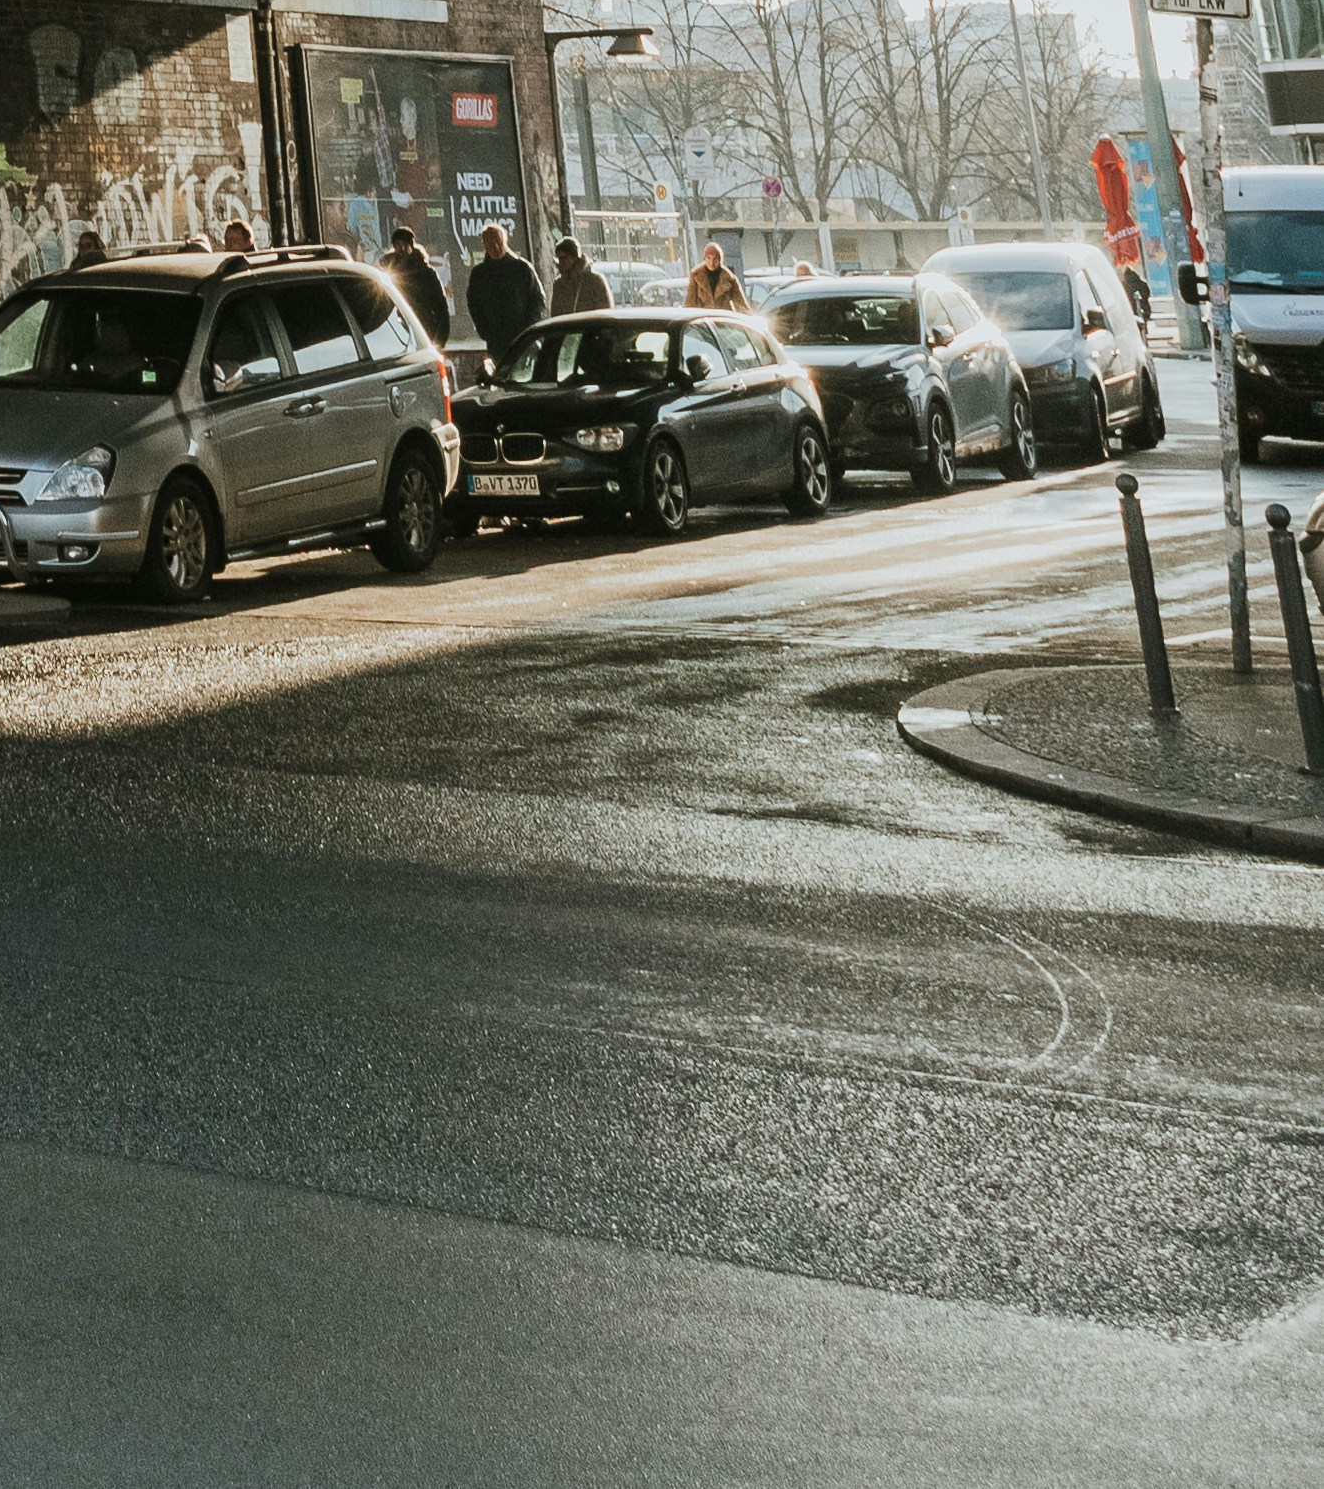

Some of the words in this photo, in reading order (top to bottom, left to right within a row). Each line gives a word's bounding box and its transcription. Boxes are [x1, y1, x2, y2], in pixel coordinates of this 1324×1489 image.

[456, 96, 494, 122] GORILLAS
[456, 172, 493, 192] NEED
[460, 196, 471, 214] A
[474, 196, 518, 215] LITTLE
[475, 477, 482, 489] B
[489, 477, 503, 490] VT
[507, 477, 537, 490] 1370
